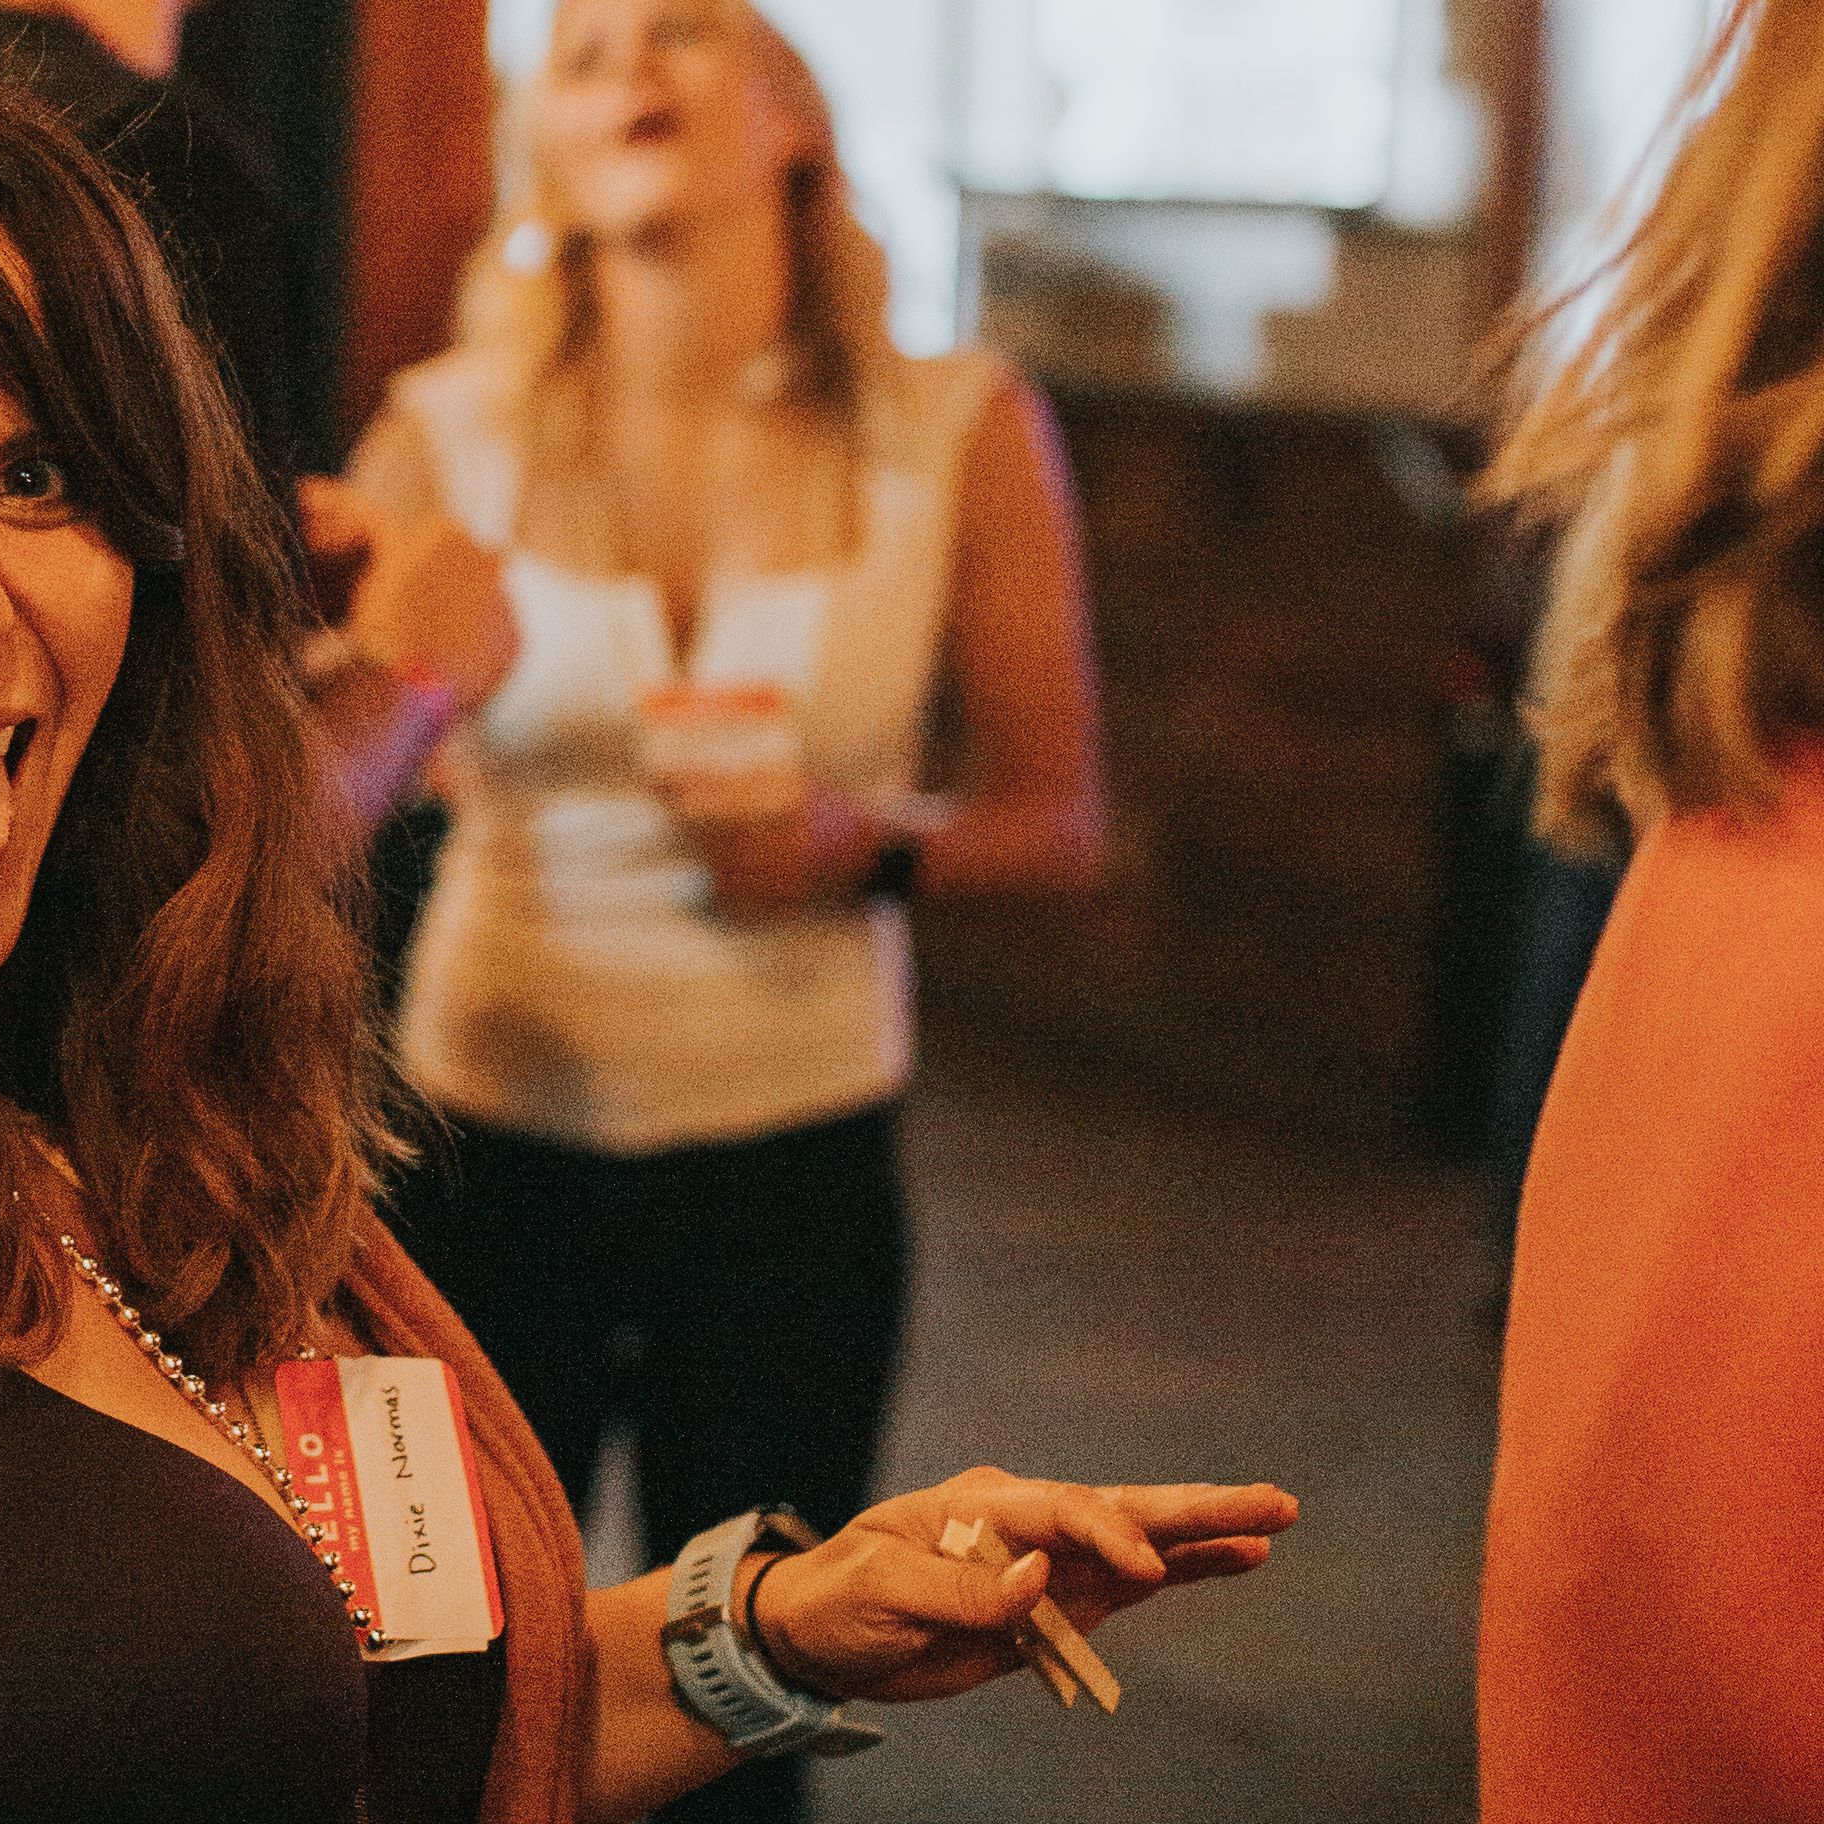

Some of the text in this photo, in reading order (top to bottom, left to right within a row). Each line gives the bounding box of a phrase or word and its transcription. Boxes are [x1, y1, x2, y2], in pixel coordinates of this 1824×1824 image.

[299, 1433, 343, 1574] ELLO
[339, 1472, 354, 1519] name
[382, 1385, 437, 1574] Dixie Normas
[347, 1525, 359, 1551] my
